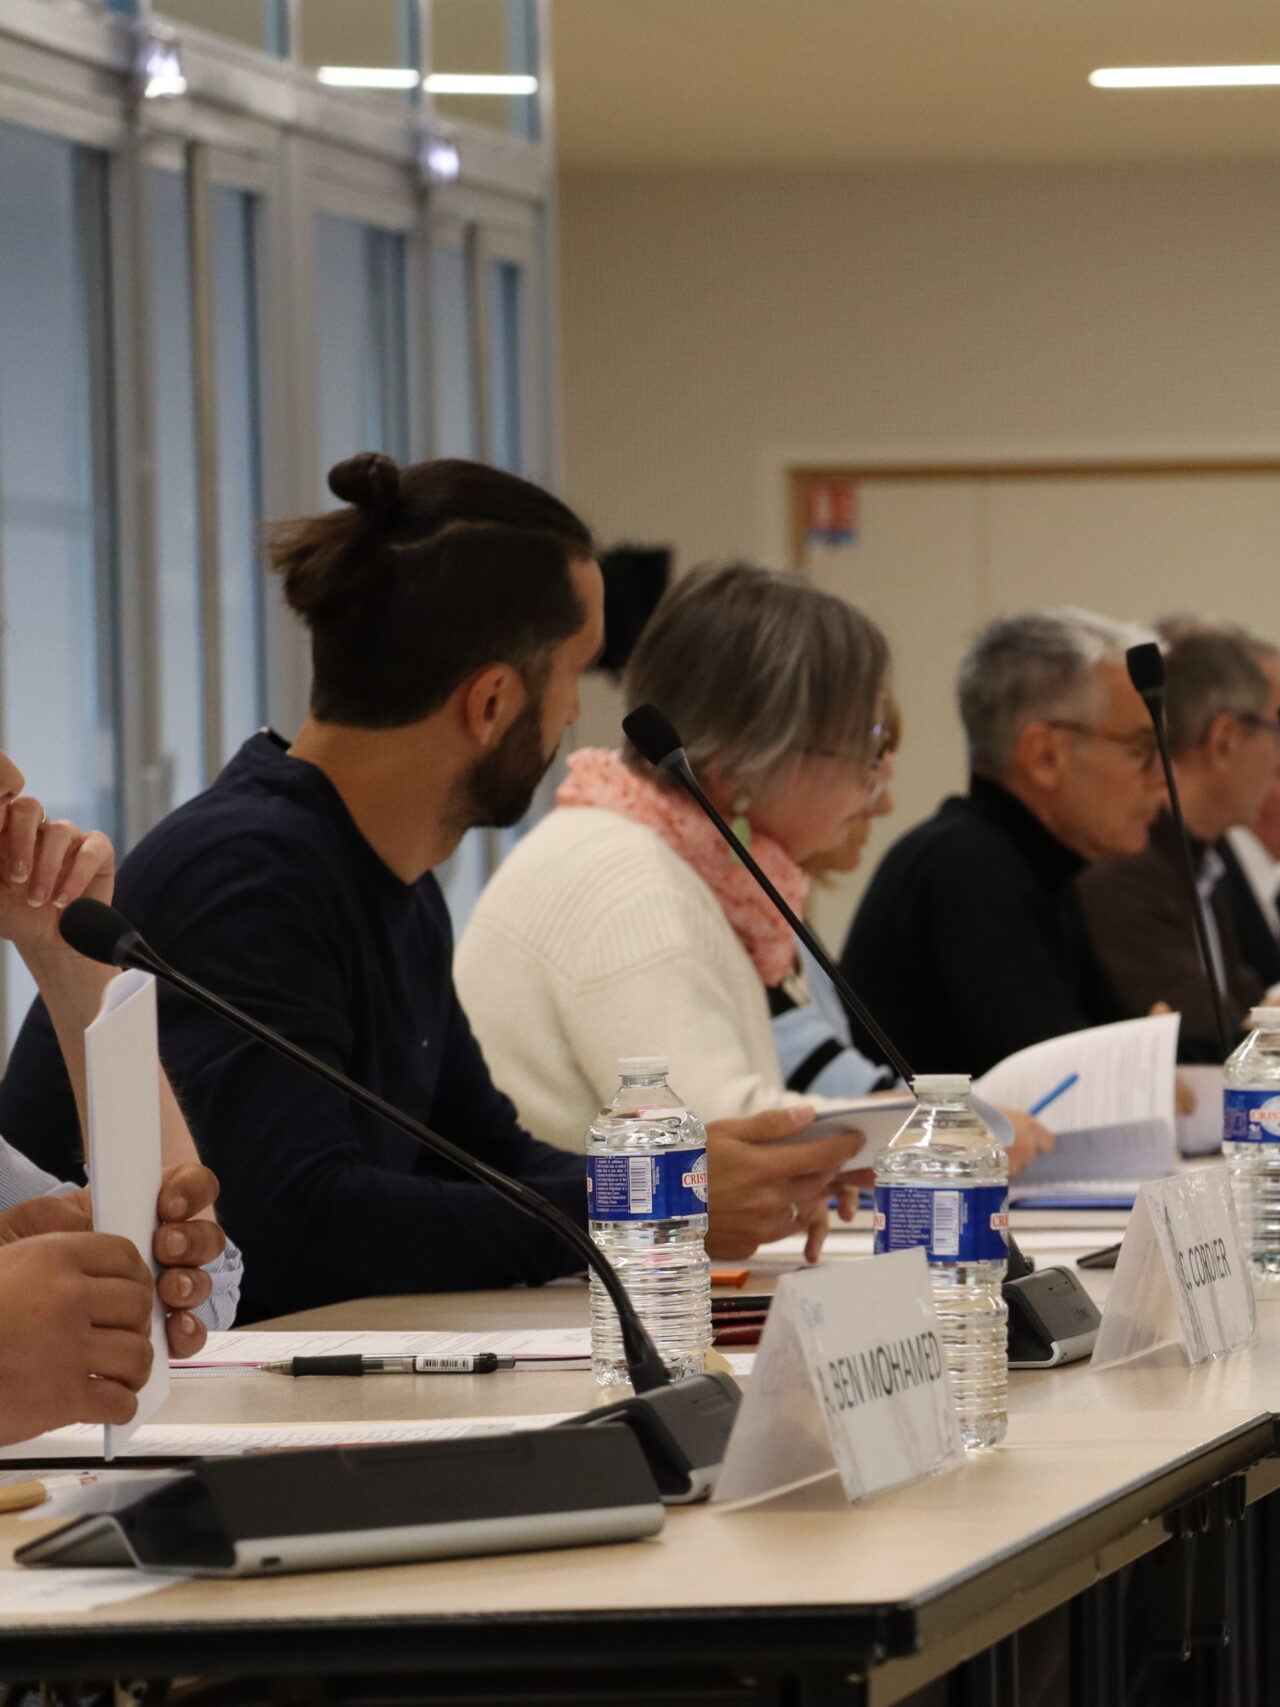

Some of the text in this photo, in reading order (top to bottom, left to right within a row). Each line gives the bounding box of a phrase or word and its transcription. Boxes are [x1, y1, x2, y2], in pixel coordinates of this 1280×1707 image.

[1188, 1237, 1232, 1288] CORDIER
[829, 1357, 865, 1411] BEN
[860, 1331, 941, 1400] MOHAMED
